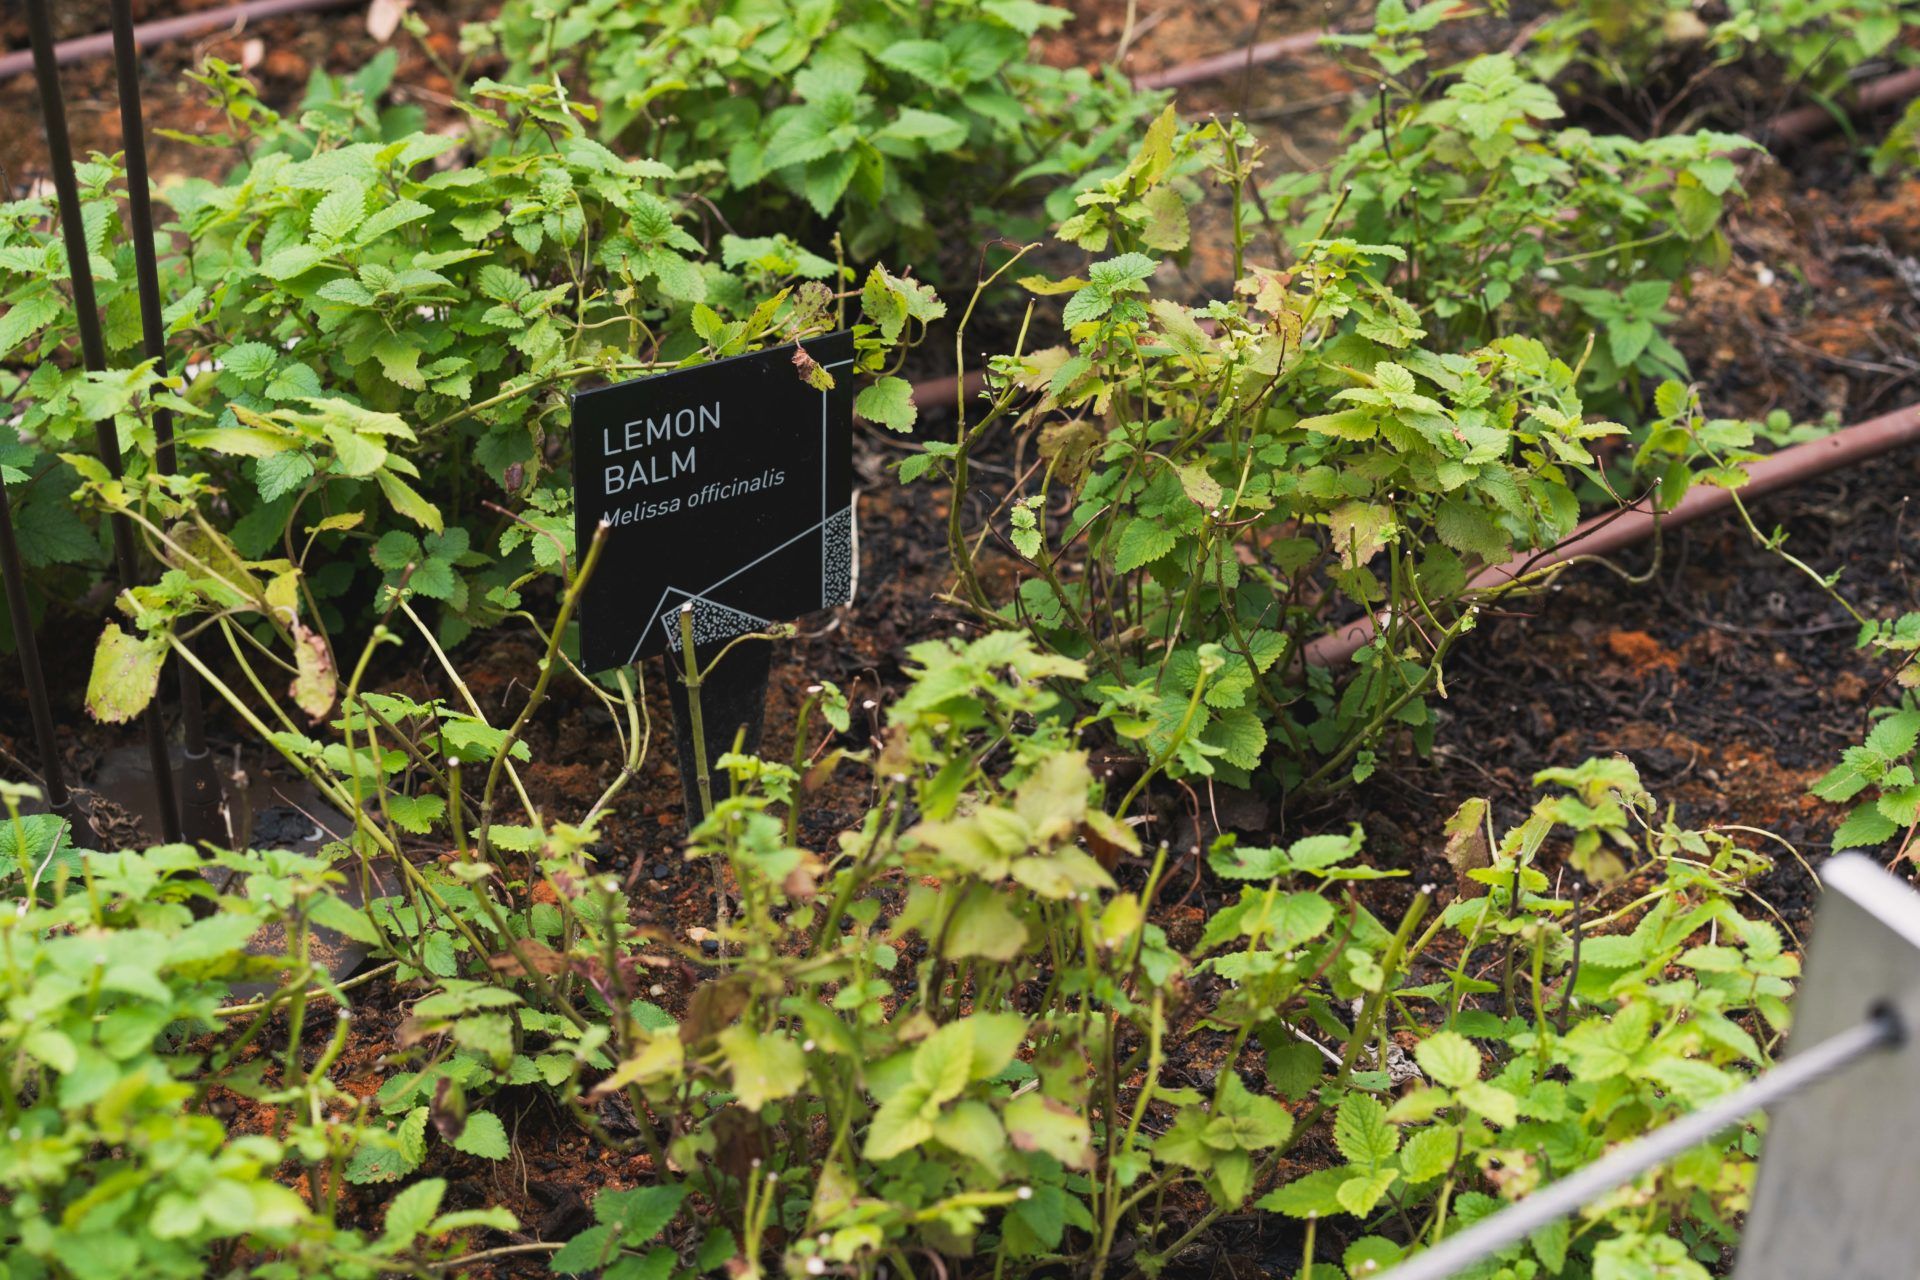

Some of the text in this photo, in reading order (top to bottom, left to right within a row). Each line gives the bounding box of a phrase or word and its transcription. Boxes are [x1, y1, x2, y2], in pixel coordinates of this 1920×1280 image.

[603, 401, 720, 456] LEMON
[602, 467, 786, 527] Melissa officinalis
[604, 446, 696, 495] BALM
